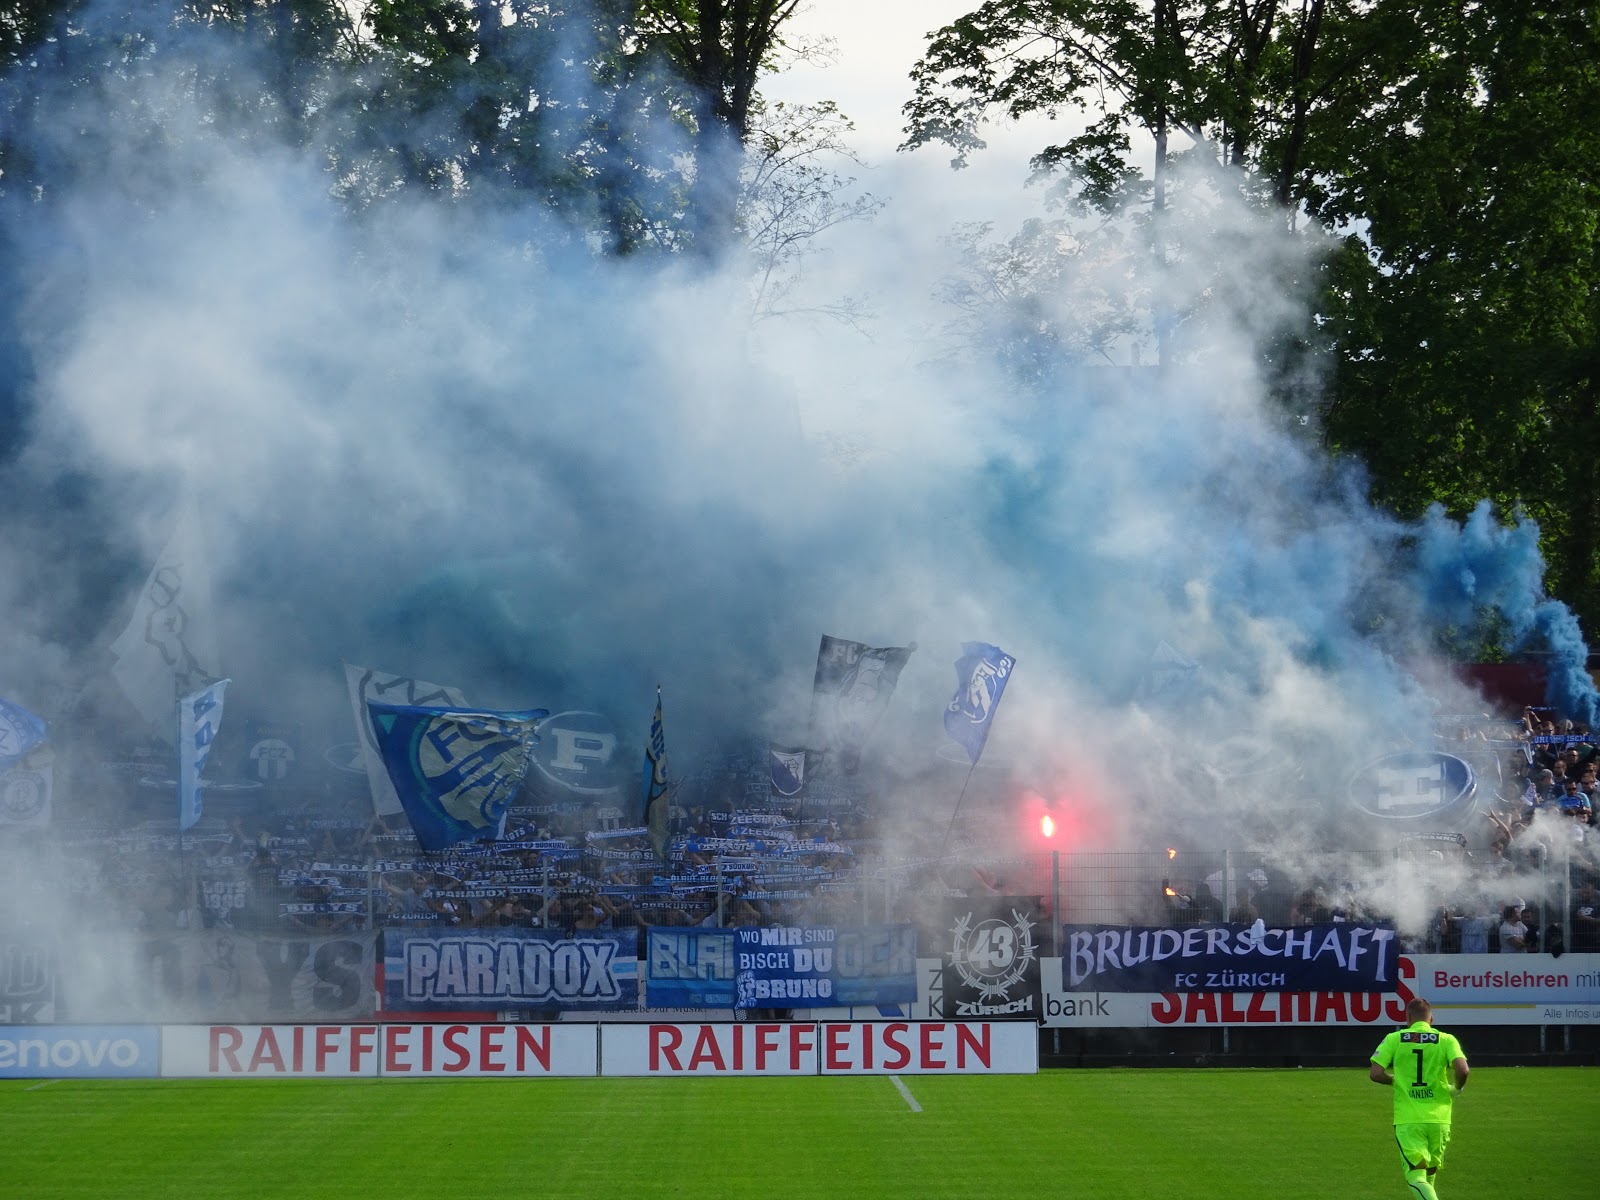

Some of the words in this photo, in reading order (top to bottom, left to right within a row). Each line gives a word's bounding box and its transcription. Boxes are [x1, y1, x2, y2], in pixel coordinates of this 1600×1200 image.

[436, 888, 508, 898] PARADOX
[740, 931, 759, 944] WO
[761, 928, 803, 945] MIR
[805, 929, 835, 942] SIND
[968, 926, 1014, 969] 43
[1070, 928, 1395, 987] BRUDERSCHAFT
[408, 941, 614, 997] PARADOX
[739, 953, 790, 970] BISCH
[793, 949, 833, 972] DU
[756, 979, 832, 999] BRUNO
[1175, 973, 1199, 988] FC
[1205, 970, 1286, 988] ZÜRICH
[1434, 971, 1569, 988] Berufslehren
[955, 996, 1033, 1016] ZÜRICH
[1544, 1009, 1562, 1018] Alle
[1565, 1009, 1589, 1018] Infos
[649, 1024, 991, 1070] RAIFFEISEN
[1403, 1033, 1437, 1043] axpo
[209, 1026, 550, 1072] RAIFFEISEN
[1412, 1049, 1427, 1087] 1
